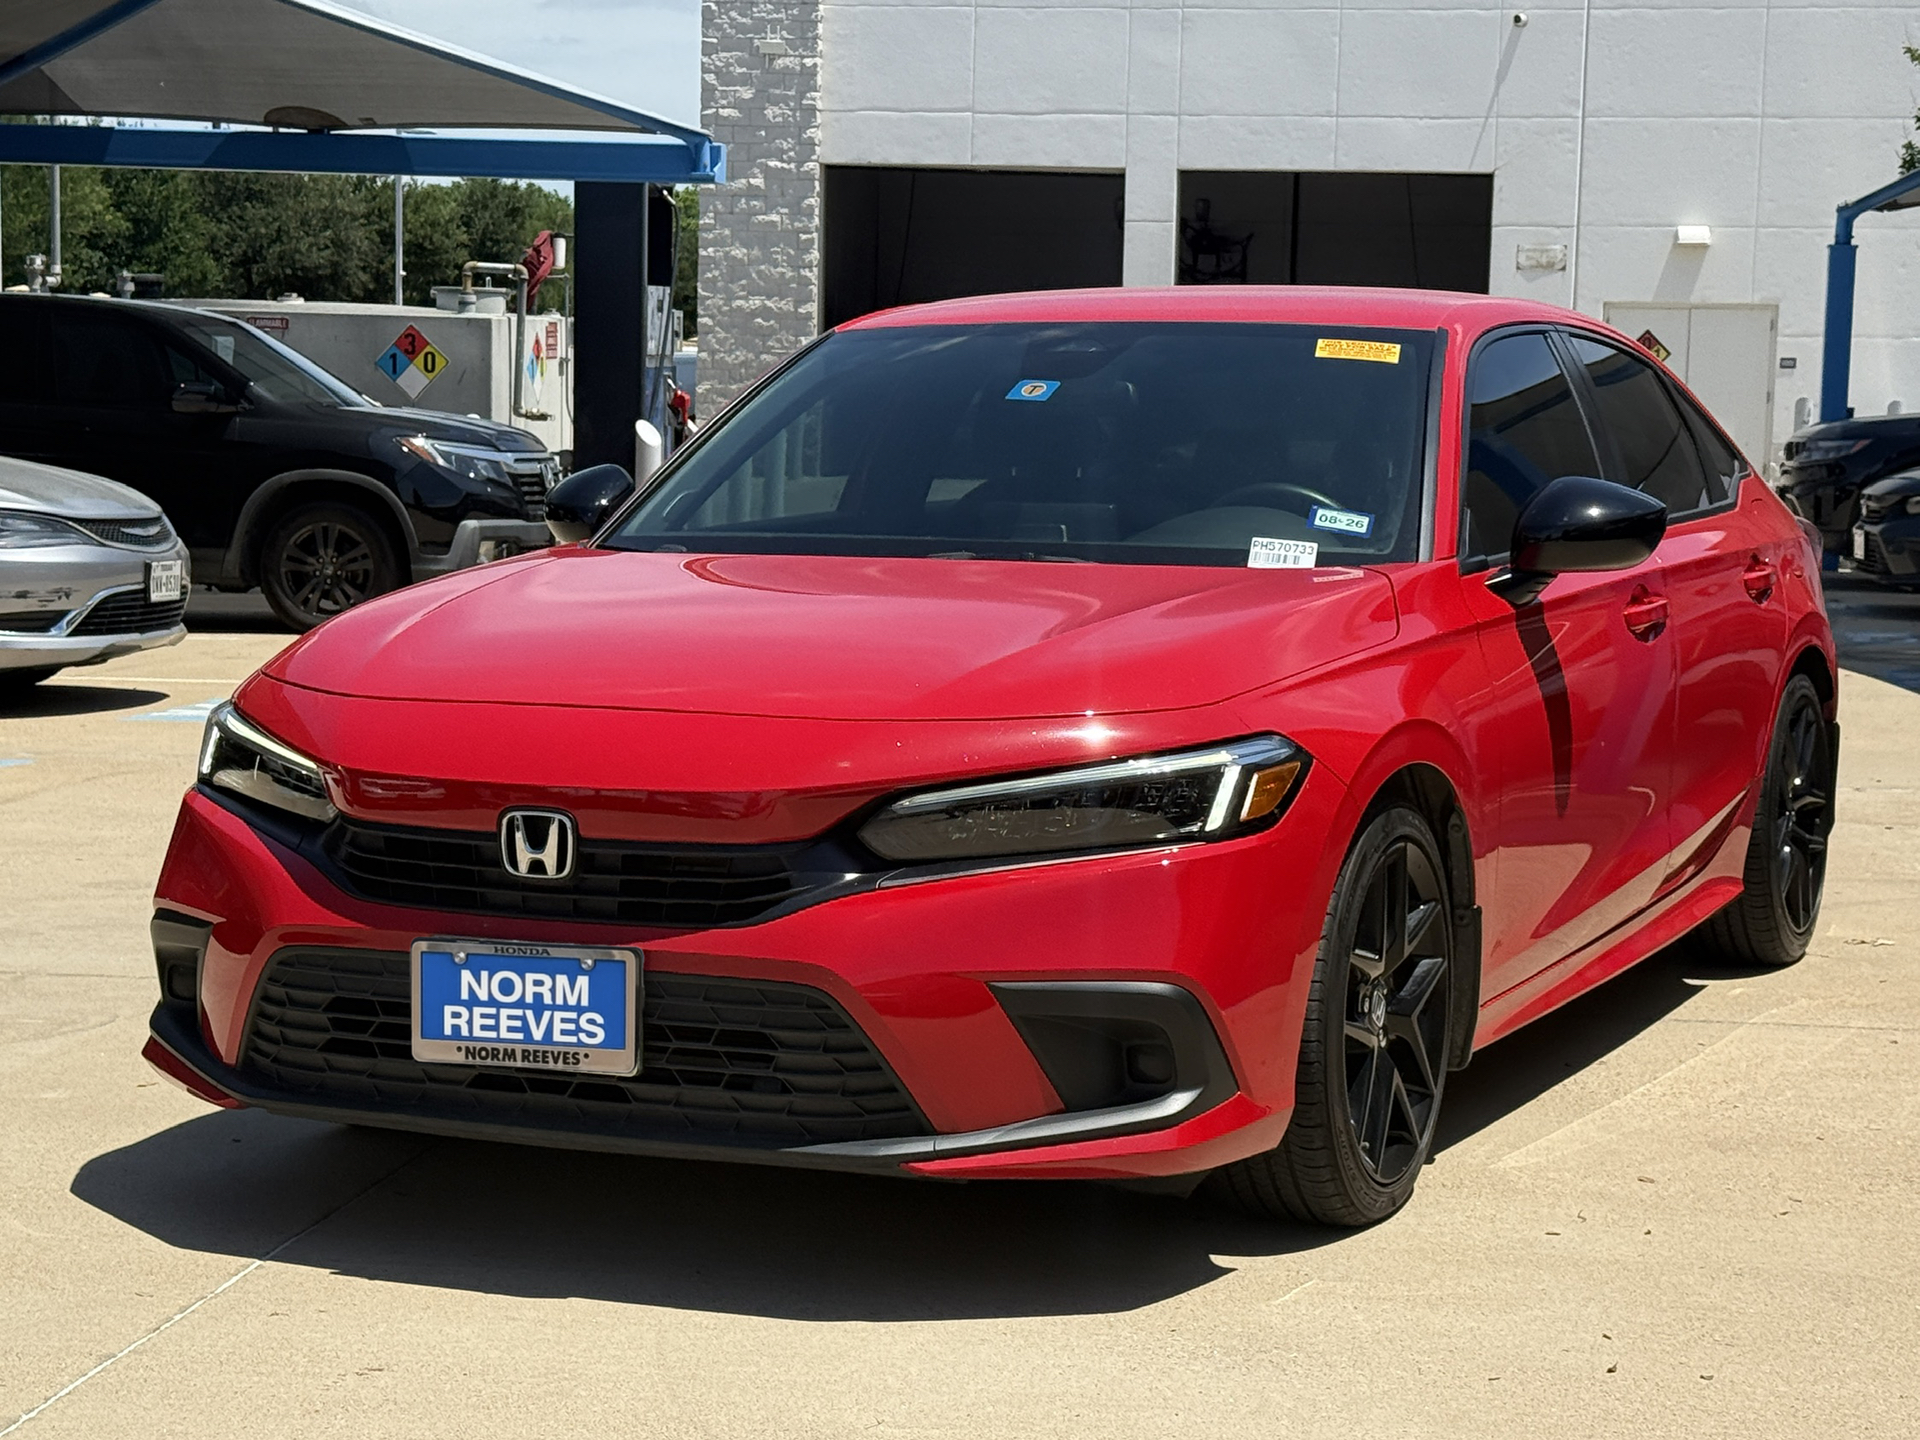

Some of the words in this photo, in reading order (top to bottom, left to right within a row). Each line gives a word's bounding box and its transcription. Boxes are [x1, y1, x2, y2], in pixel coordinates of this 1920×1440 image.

[404, 333, 416, 355] 3
[389, 353, 398, 375] 1
[423, 351, 436, 374] 0
[1030, 385, 1044, 394] T
[1252, 540, 1315, 556] PH570733
[493, 946, 551, 956] HONDA
[460, 969, 589, 1007] NORM
[443, 1005, 606, 1045] REEVES
[465, 1046, 517, 1063] NORM
[521, 1049, 581, 1066] REEVES
